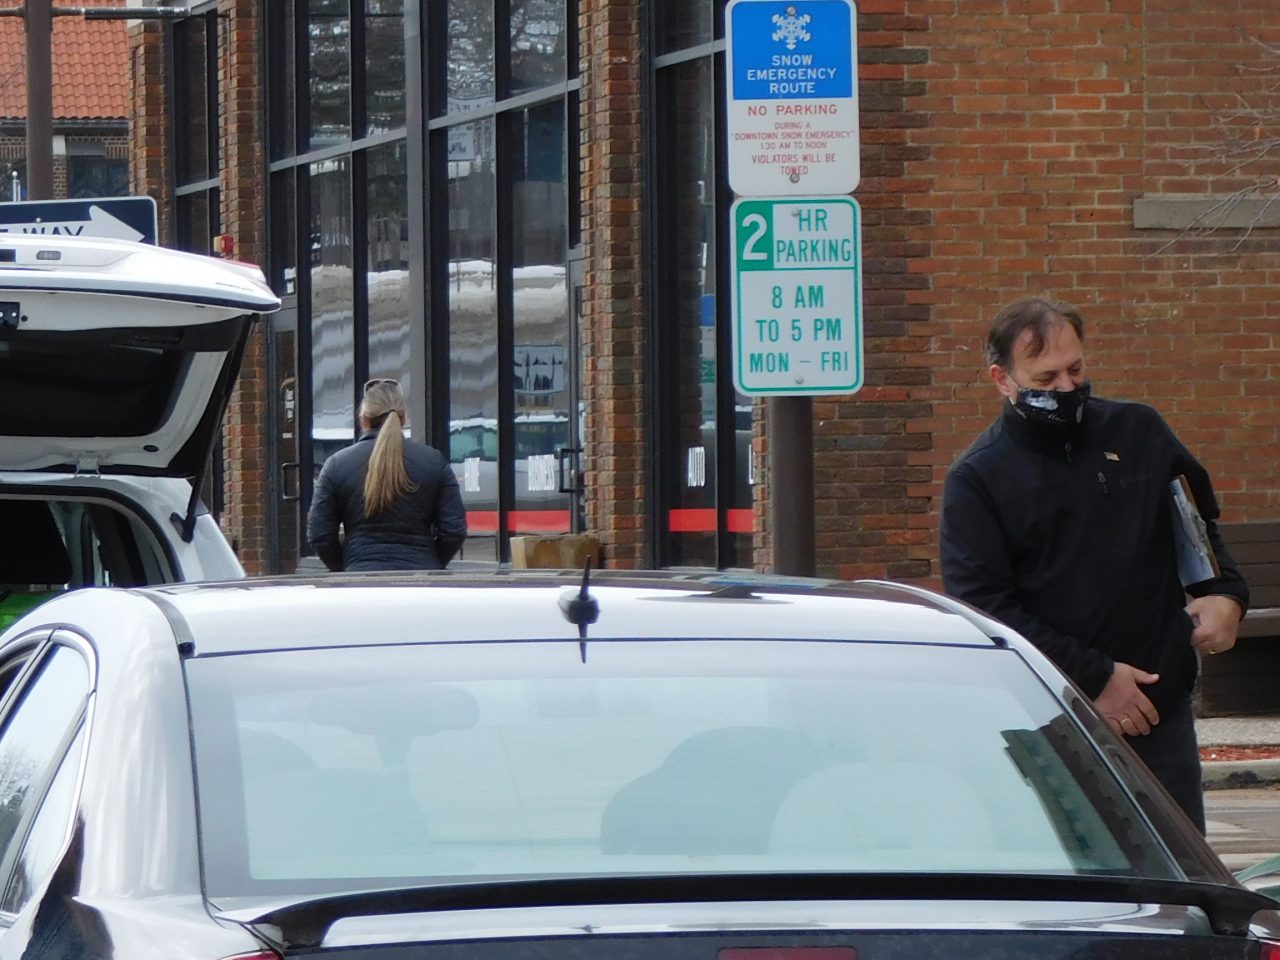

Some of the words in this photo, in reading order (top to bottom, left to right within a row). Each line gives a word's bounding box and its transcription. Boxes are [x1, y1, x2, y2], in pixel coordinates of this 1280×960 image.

[772, 54, 813, 66] SNOW
[747, 68, 837, 81] EMERGENCY
[770, 82, 816, 94] ROUTE
[748, 105, 768, 117] NO
[776, 104, 837, 116] PARKING
[775, 122, 802, 130] DURING
[806, 121, 811, 129] A
[806, 141, 827, 149] NOON
[752, 154, 799, 163] VIOLATORS
[802, 154, 821, 163] WILL
[825, 153, 836, 162] BE
[780, 166, 809, 175] TOWED
[742, 213, 768, 261] 2
[798, 208, 828, 232] HR
[776, 238, 852, 263] PARKING
[772, 285, 783, 309] 8
[794, 285, 824, 309] AM
[755, 319, 779, 342] TO
[791, 319, 802, 342] 5
[813, 318, 842, 341] PM
[749, 353, 789, 373] MON
[821, 351, 848, 372] FRI
[688, 446, 706, 487] AUTO
